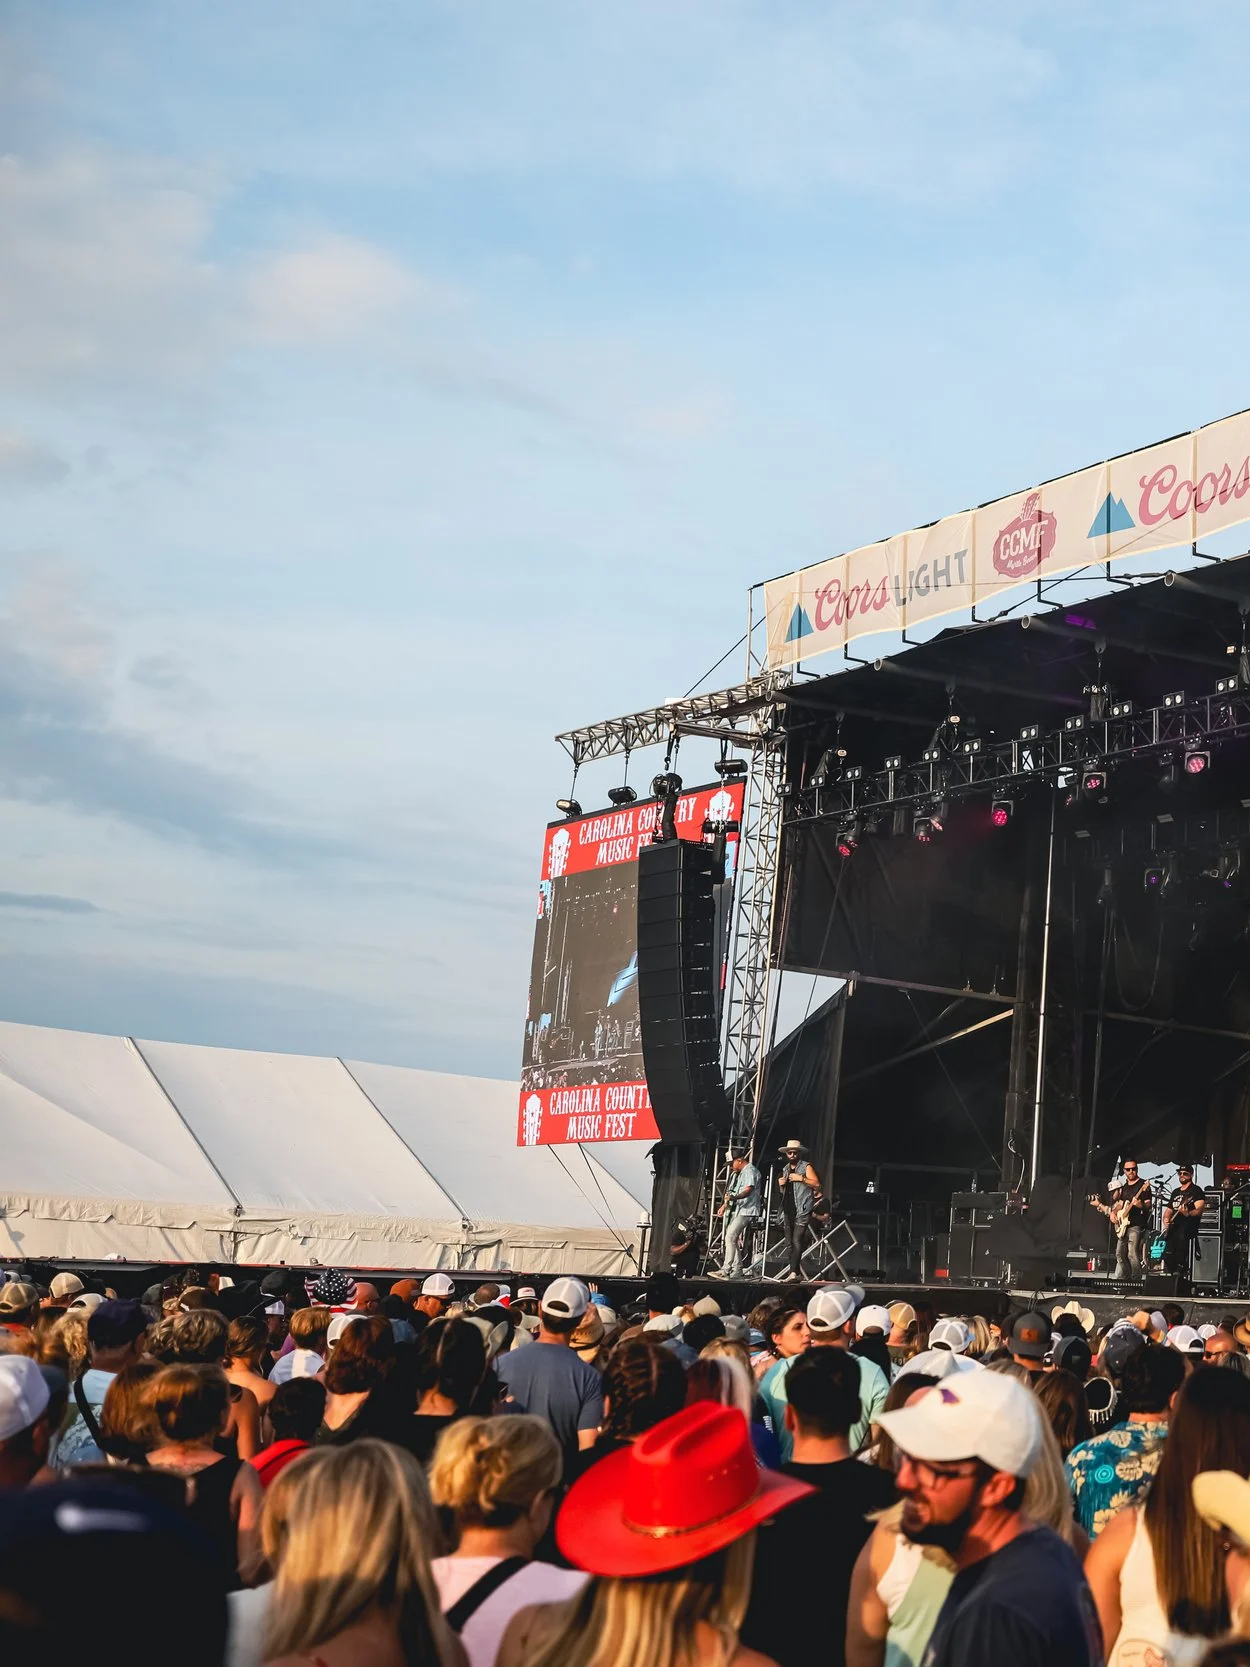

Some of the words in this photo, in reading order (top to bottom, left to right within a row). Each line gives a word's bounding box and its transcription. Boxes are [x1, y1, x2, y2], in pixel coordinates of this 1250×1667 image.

[1000, 519, 1049, 560] CCMF
[814, 575, 890, 631] Coors
[894, 549, 968, 607] LIGHT
[578, 811, 634, 846] CAROLINA
[637, 797, 697, 830] COURY
[595, 836, 634, 866] MUSIC
[549, 1087, 601, 1116] CAROLINA
[605, 1084, 653, 1111] COUNT
[566, 1114, 603, 1140] MUSIC
[604, 1111, 638, 1138] FEST
